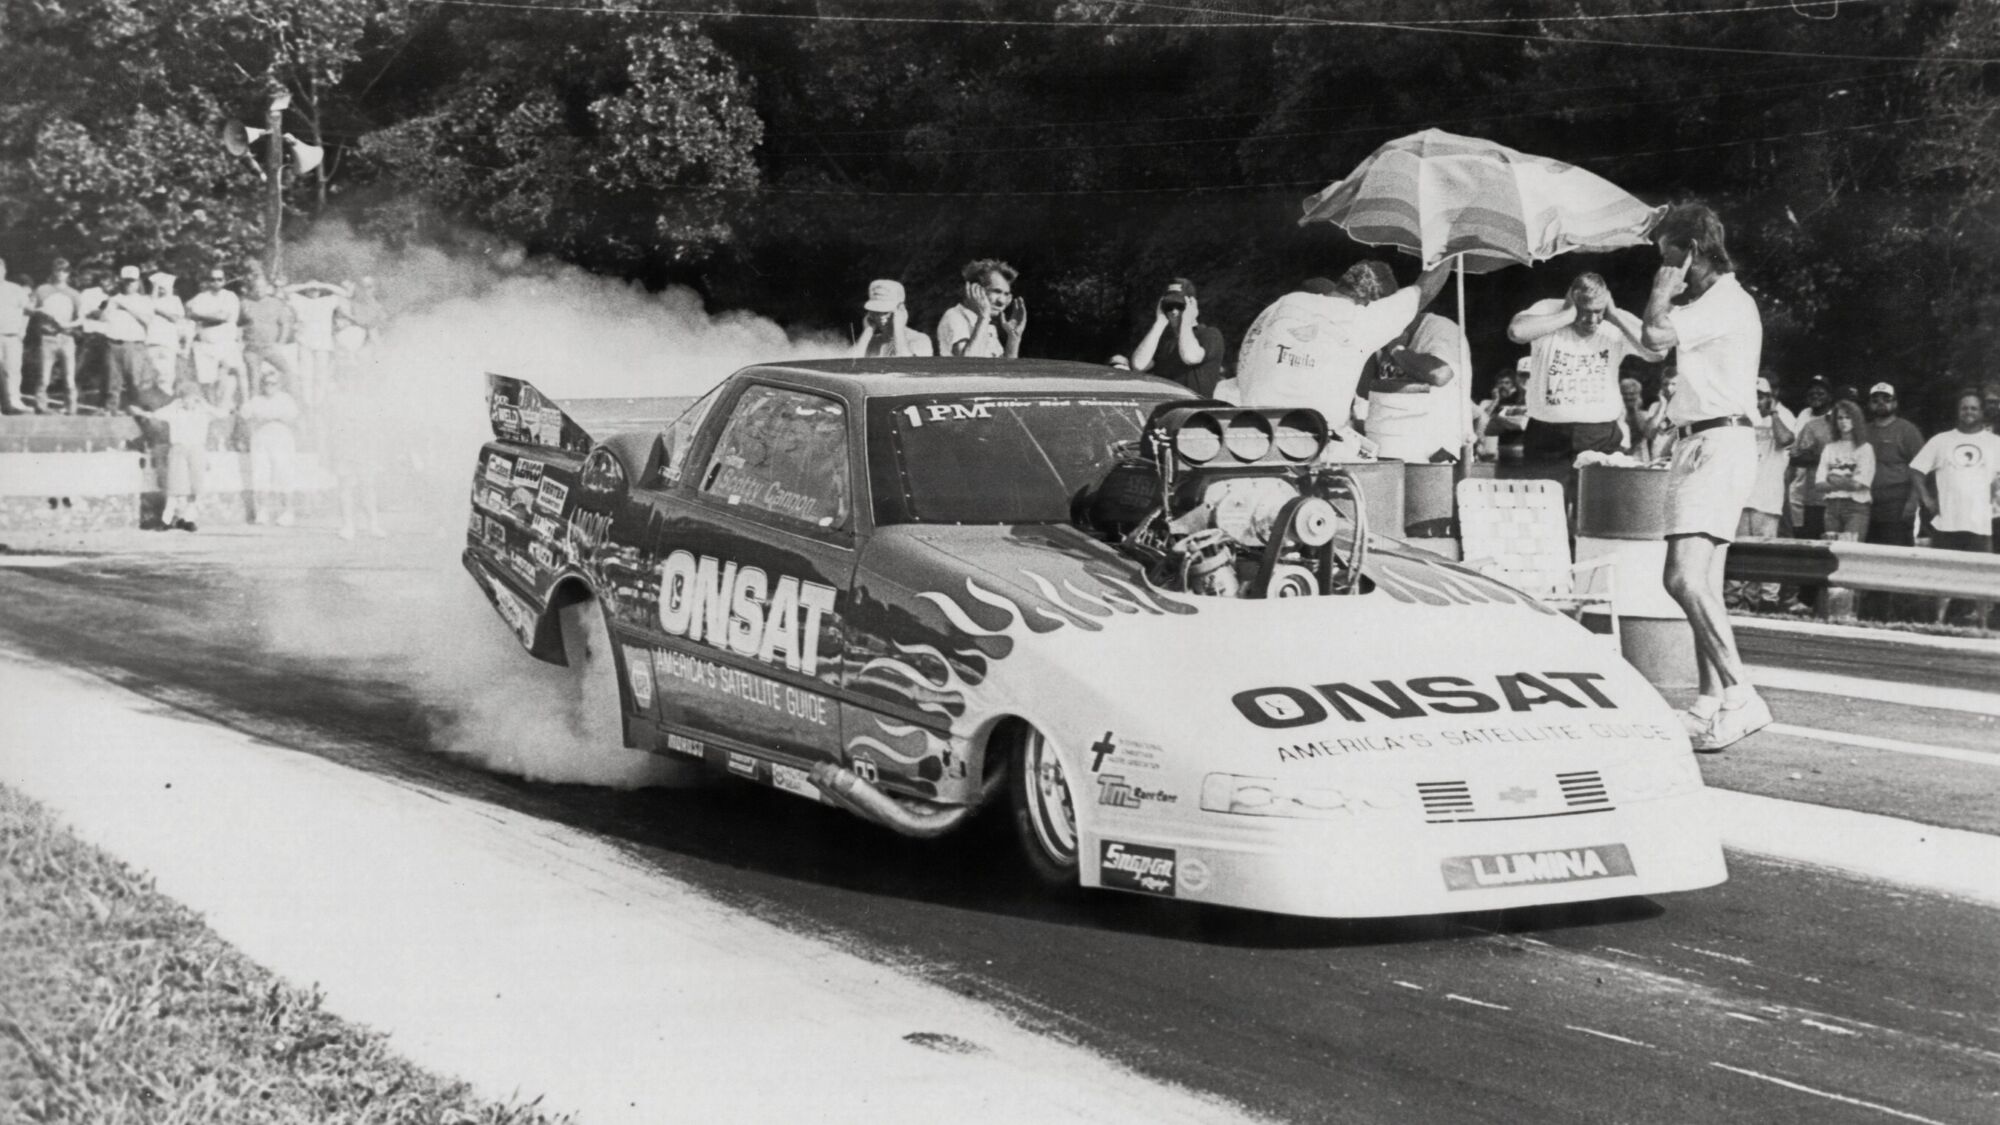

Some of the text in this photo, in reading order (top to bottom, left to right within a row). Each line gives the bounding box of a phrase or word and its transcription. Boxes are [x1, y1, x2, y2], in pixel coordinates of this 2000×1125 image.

[903, 403, 993, 427] 1 PM
[658, 549, 837, 676] ONSAT
[657, 647, 717, 689] AMERICA'S
[720, 665, 782, 711] SATELLITE
[785, 686, 827, 726] GUIDE
[1231, 671, 1618, 728] ONSAT
[1277, 722, 1672, 763] AMERICA'S SATELLITE GUIDE
[1470, 848, 1608, 886] LUMINA
